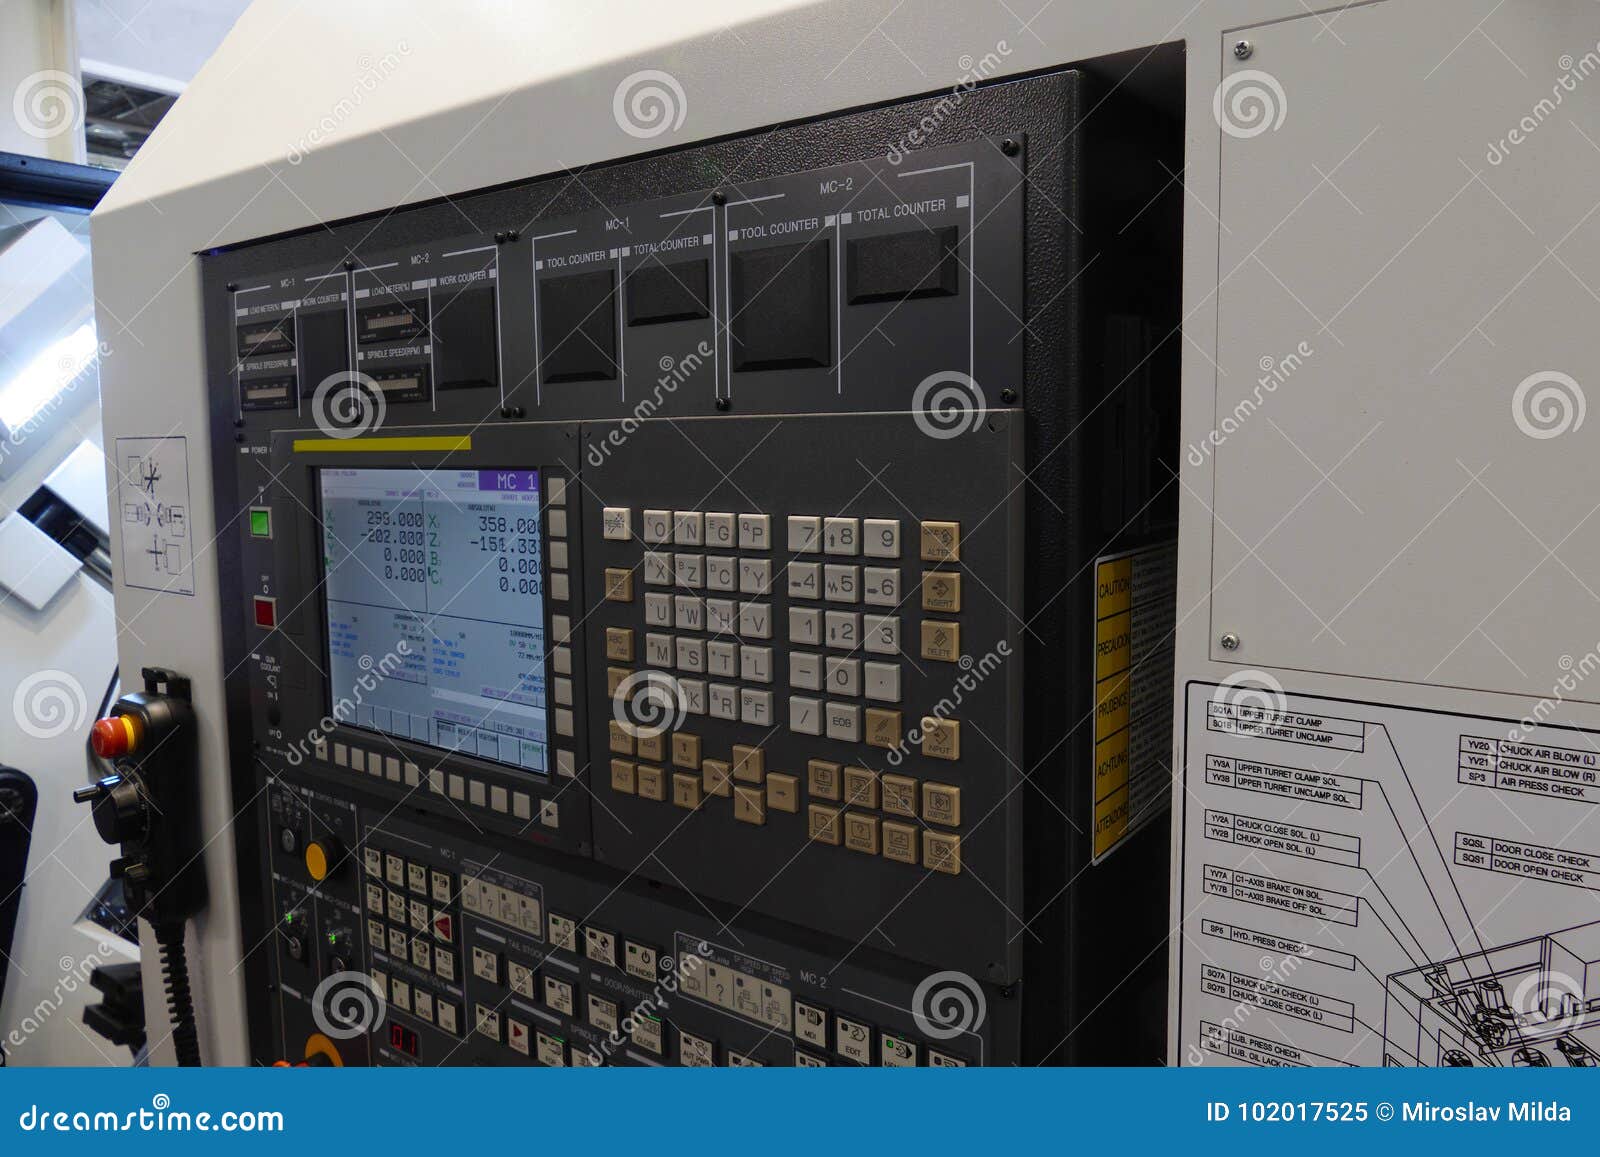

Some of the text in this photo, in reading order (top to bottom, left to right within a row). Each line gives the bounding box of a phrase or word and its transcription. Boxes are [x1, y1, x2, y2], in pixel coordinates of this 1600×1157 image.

[819, 180, 854, 195] MC-2
[857, 199, 946, 222] TOTAL COUNTER
[605, 218, 630, 232] MC-1
[740, 218, 819, 240] TOOL COUNTER
[633, 236, 700, 256] TOTAL COUNTER
[411, 253, 431, 265] MC-2
[546, 251, 606, 269] TOOL COUNTER
[439, 270, 487, 286] WORK COUNTER
[497, 473, 536, 490] MC 1
[655, 522, 665, 537] O
[686, 525, 696, 539] N
[718, 526, 728, 541] G
[752, 528, 762, 543] P
[803, 526, 815, 543] 7
[840, 528, 853, 545] 8
[881, 530, 894, 547] 9
[656, 564, 665, 578] X
[687, 567, 696, 582] Z
[719, 569, 730, 584] C
[753, 572, 764, 587] Y
[803, 573, 815, 590] 4
[841, 575, 853, 592] 5
[881, 579, 894, 596] 6
[657, 606, 666, 621] U
[686, 609, 698, 624] W
[719, 614, 730, 629] H
[753, 617, 764, 633] V
[806, 619, 812, 635] 1
[842, 623, 853, 640] 2
[881, 628, 893, 644] 3
[657, 646, 668, 661] M
[688, 651, 699, 665] S
[719, 655, 730, 670] T
[754, 660, 764, 675] L
[833, 716, 851, 728] EOB
[1296, 717, 1322, 728] CLAMP
[1265, 726, 1293, 739] TURRET
[1296, 731, 1333, 744] UNCLAMP
[1468, 740, 1490, 751] YV20
[1468, 756, 1488, 767] YV21
[1500, 744, 1596, 766] CHUCK AIR BLOW (L)
[1238, 763, 1263, 775] UPPER
[1264, 767, 1292, 780] TURRET
[1294, 772, 1321, 784] CLAMP
[1468, 772, 1486, 782] SP3
[1500, 761, 1596, 782] CHUCK AIR BLOW (R)
[1237, 777, 1331, 800] UPPER TURRET UNCLAMP
[1501, 777, 1585, 797] AIR PRESS CHECK
[1236, 818, 1263, 832] CHUCK
[1264, 824, 1288, 837] CLOSE
[1236, 832, 1262, 845] CHUCK
[1263, 838, 1284, 849] OPEN
[1495, 843, 1590, 868] DOOR CLOSE CHECK
[1494, 859, 1584, 883] DOOR OPEN CHECK
[1266, 881, 1291, 894] BRAKE
[1292, 887, 1304, 897] ON
[1265, 895, 1291, 908] BRAKE
[1292, 901, 1308, 911] OFF
[1252, 936, 1276, 948] PRESS
[800, 969, 817, 985] MC
[1232, 976, 1259, 990] CHUCK
[1281, 988, 1308, 1002] CHECK
[1232, 990, 1258, 1003] CHUCK
[1285, 1003, 1311, 1018] CHECK
[845, 1046, 861, 1057] EDIT
